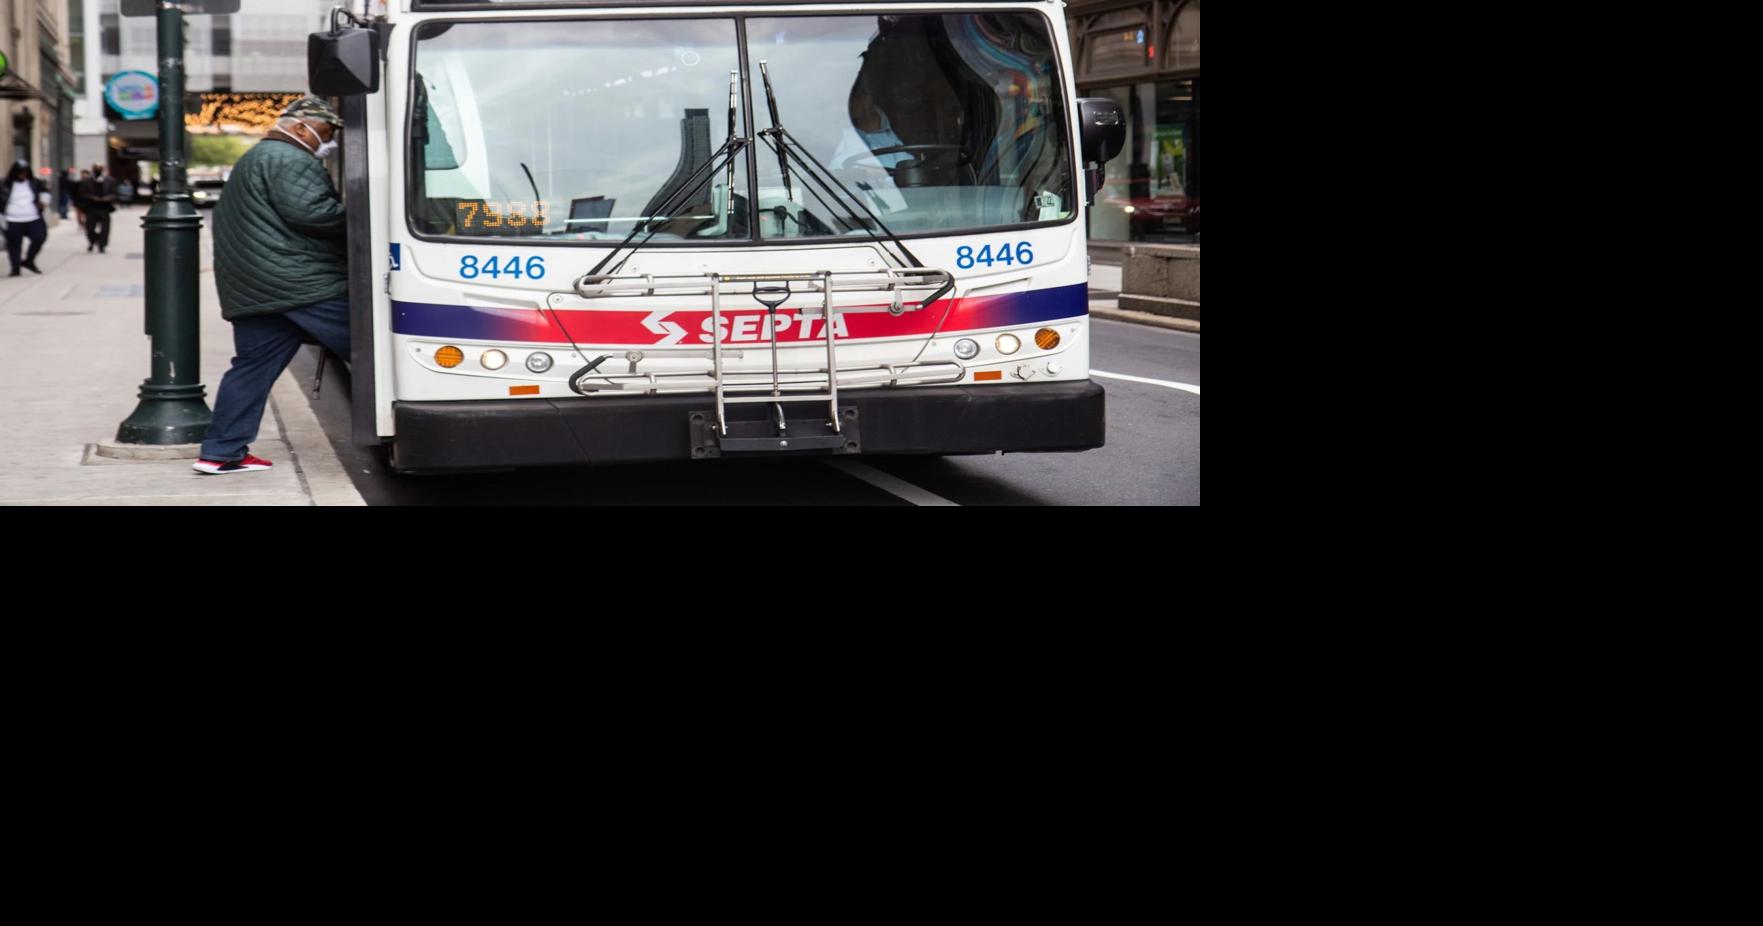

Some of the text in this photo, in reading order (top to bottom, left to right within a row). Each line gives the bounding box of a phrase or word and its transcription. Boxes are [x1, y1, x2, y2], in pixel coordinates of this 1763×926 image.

[459, 254, 546, 280] 8446
[956, 241, 1034, 270] 8446
[698, 312, 849, 344] SEPTA
